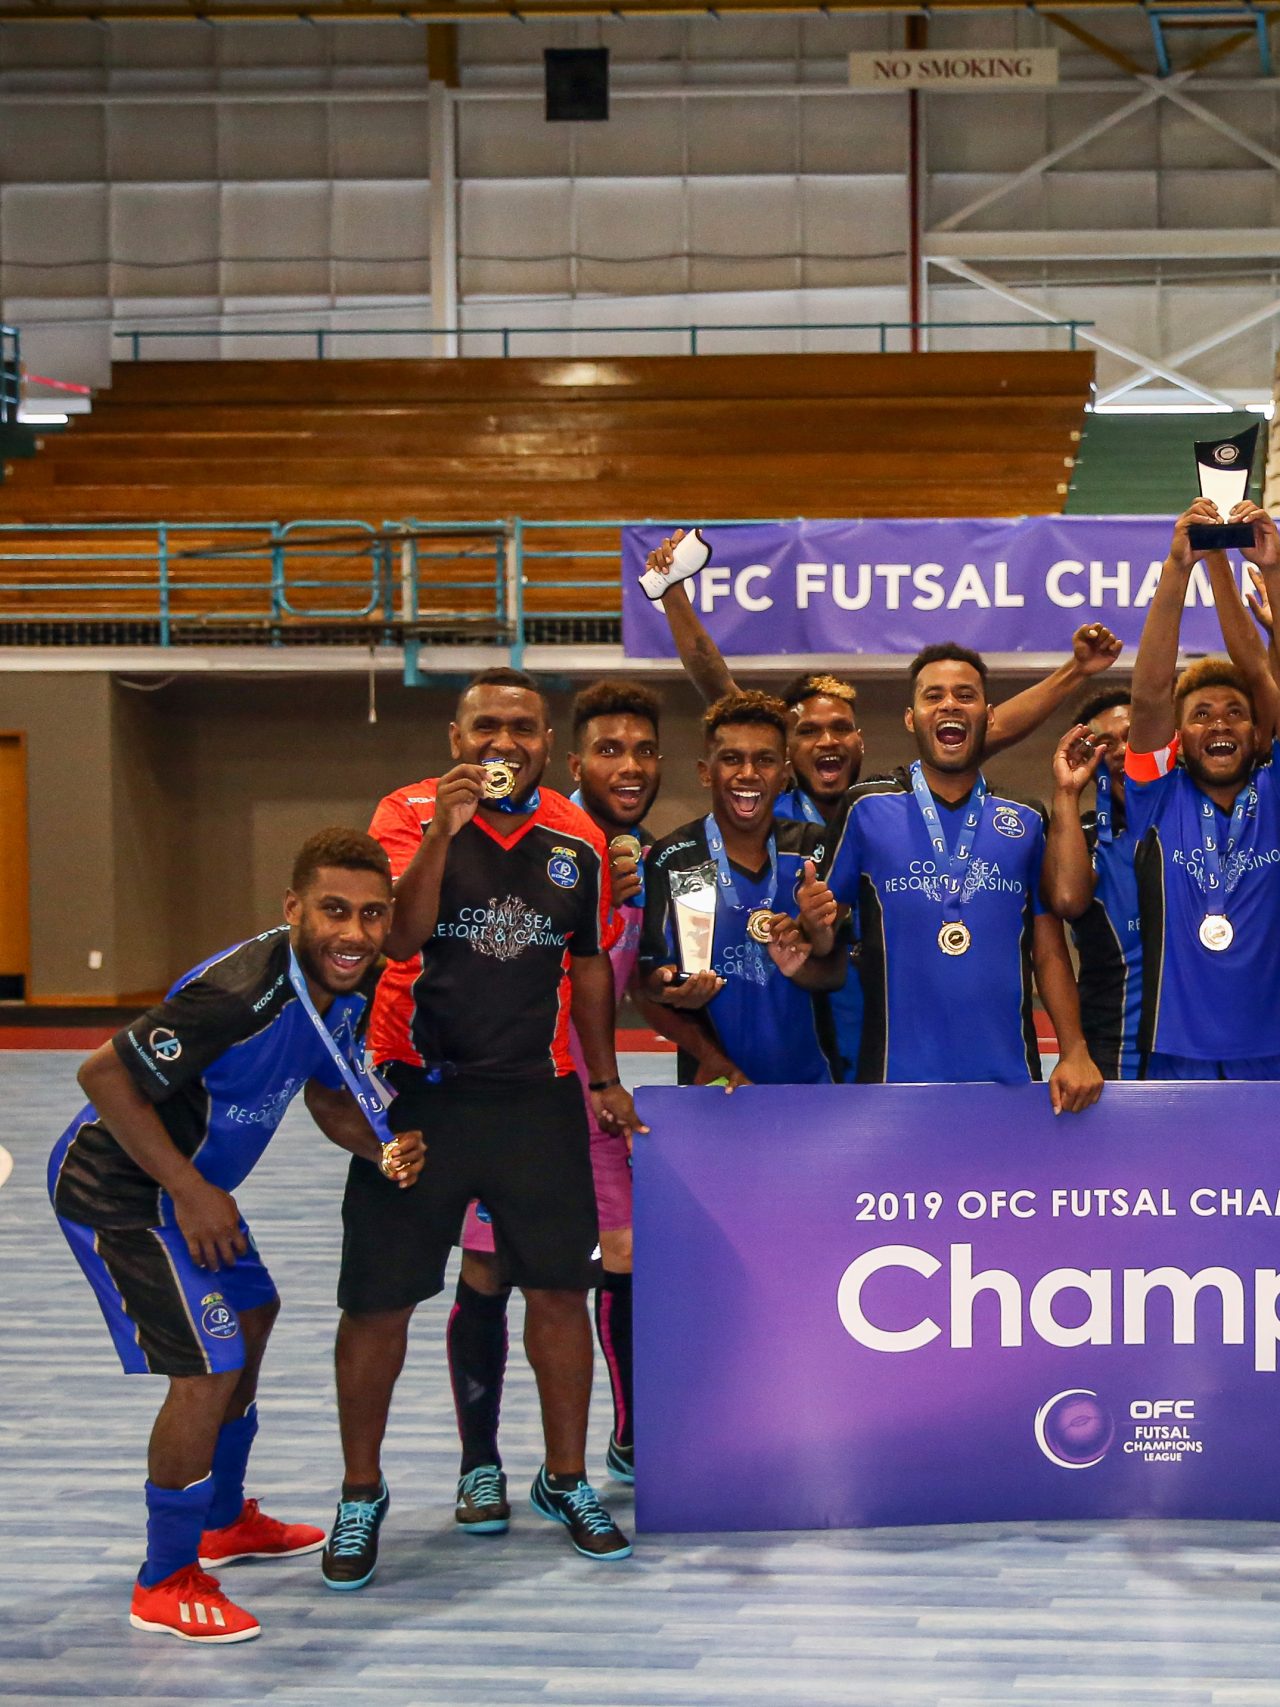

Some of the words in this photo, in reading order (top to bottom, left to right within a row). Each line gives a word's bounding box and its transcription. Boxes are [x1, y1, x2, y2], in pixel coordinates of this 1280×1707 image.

[873, 59, 911, 80] NO
[917, 58, 1033, 79] SMOKING
[651, 563, 774, 614] FC
[796, 561, 1025, 611] FUTSAL
[971, 862, 1001, 876] SEA
[885, 876, 939, 893] RESORT
[964, 877, 1023, 894] CASINO
[460, 907, 516, 927] CORAL
[523, 912, 552, 931] SEA
[432, 923, 489, 941] ESORT
[494, 928, 506, 942] &
[855, 1191, 943, 1221] 2019
[957, 1190, 1037, 1219] OFC
[1052, 1188, 1177, 1217] FUTSAL
[1129, 1400, 1195, 1419] OFC
[1135, 1426, 1190, 1439] FUTSAL
[1123, 1440, 1203, 1454] CHAMPIONS
[1144, 1452, 1182, 1462] LEAGUE
